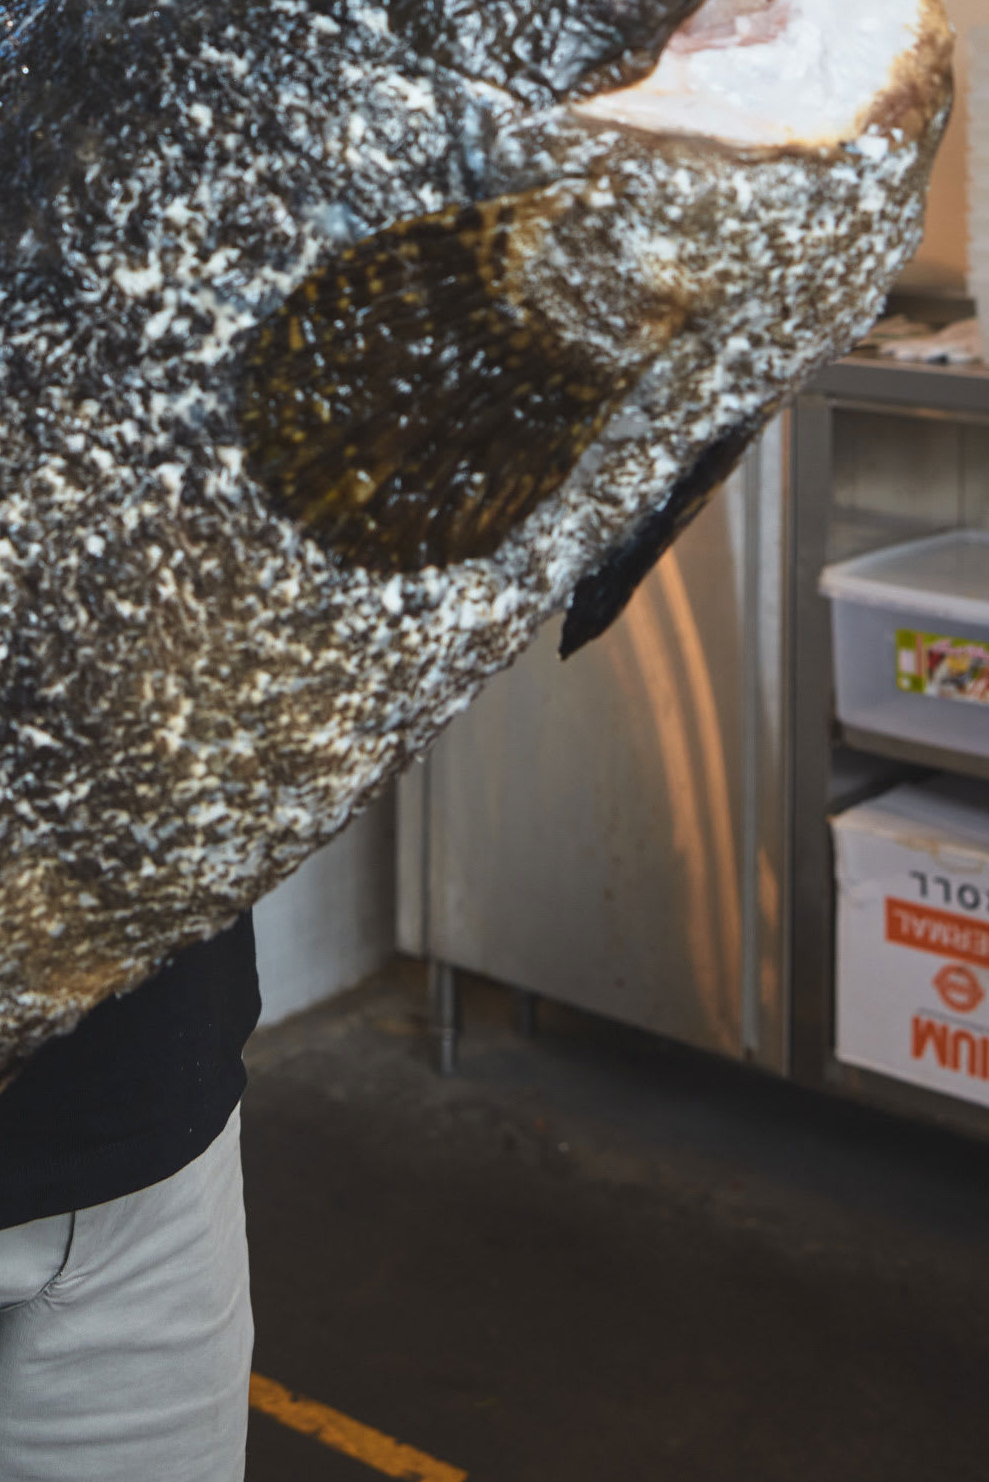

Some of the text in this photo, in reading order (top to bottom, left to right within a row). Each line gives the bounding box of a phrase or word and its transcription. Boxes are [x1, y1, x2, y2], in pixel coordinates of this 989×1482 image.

[909, 869, 989, 914] OLL
[892, 909, 989, 958] ERMAL
[911, 1014, 989, 1083] IUM
